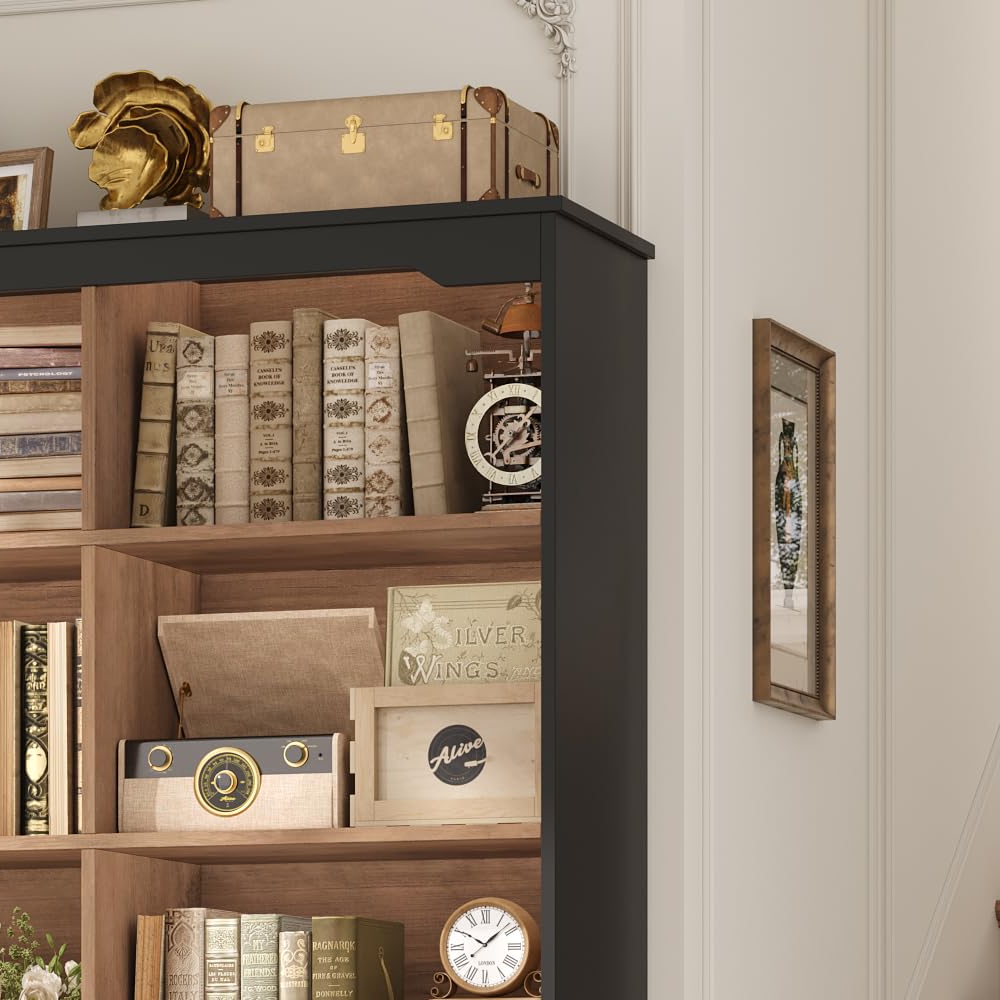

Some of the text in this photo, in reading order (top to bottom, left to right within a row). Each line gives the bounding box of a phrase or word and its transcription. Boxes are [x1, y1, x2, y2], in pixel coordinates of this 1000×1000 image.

[402, 654, 499, 684] WINGS
[429, 737, 483, 772] Alive
[252, 939, 266, 951] MY
[317, 956, 333, 964] THE
[315, 990, 354, 998] DONNELLY
